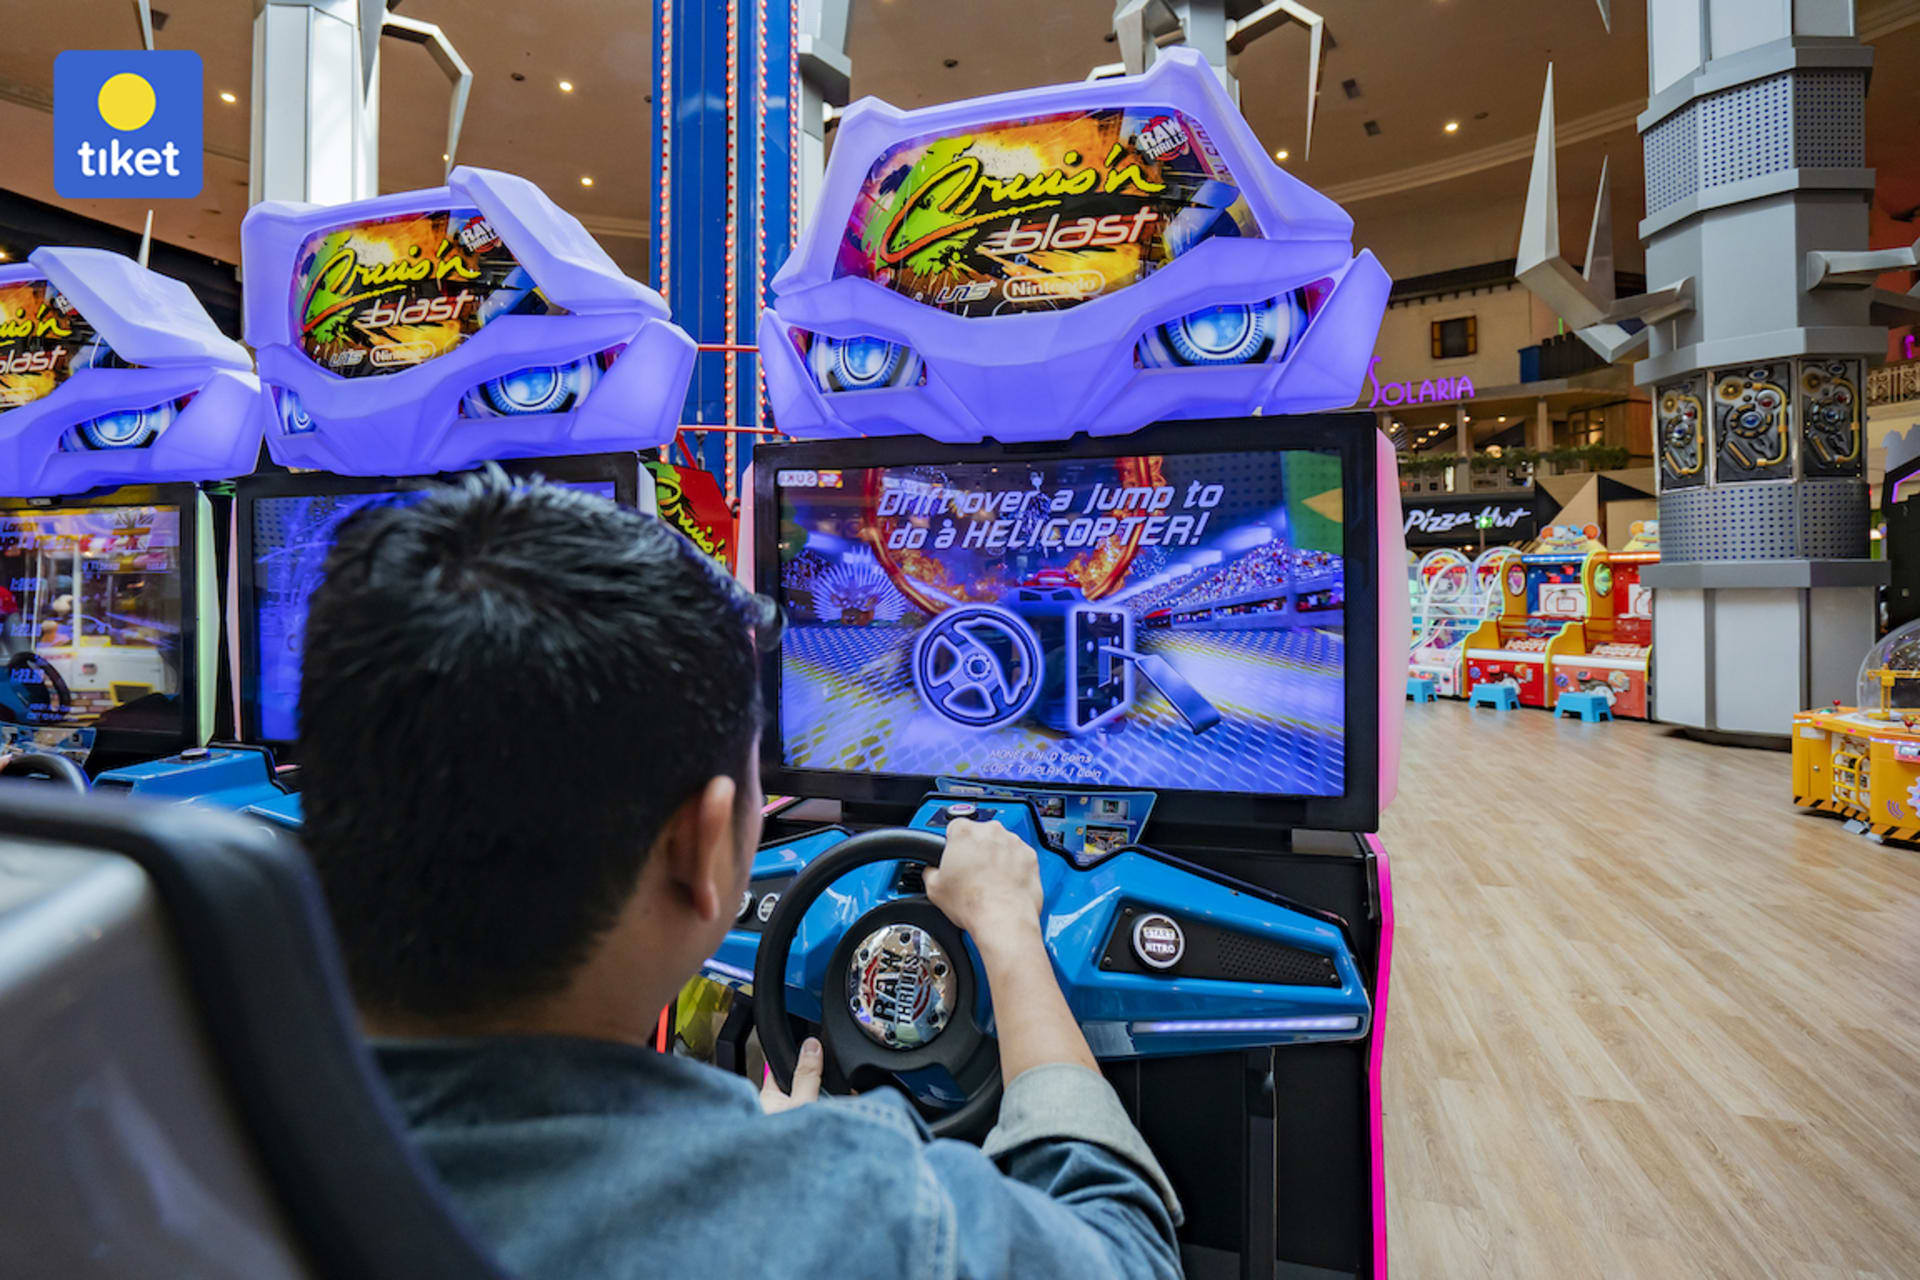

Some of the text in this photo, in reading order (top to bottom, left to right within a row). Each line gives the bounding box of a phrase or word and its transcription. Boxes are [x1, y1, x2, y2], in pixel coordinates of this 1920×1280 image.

[1137, 118, 1183, 152] RAW
[1145, 133, 1189, 160] THRILLS
[990, 207, 1159, 254] blast
[1011, 278, 1096, 296] Nintendo
[358, 289, 475, 328] blast
[877, 487, 950, 517] Drift
[962, 489, 1040, 514] over
[1050, 489, 1074, 512] a
[1183, 480, 1225, 509] to
[888, 522, 928, 549] do
[961, 511, 1210, 549] HELICOPTER!
[1404, 506, 1532, 534] Pizza Hut
[1144, 942, 1176, 954] NITRO
[872, 947, 903, 1022] RAW
